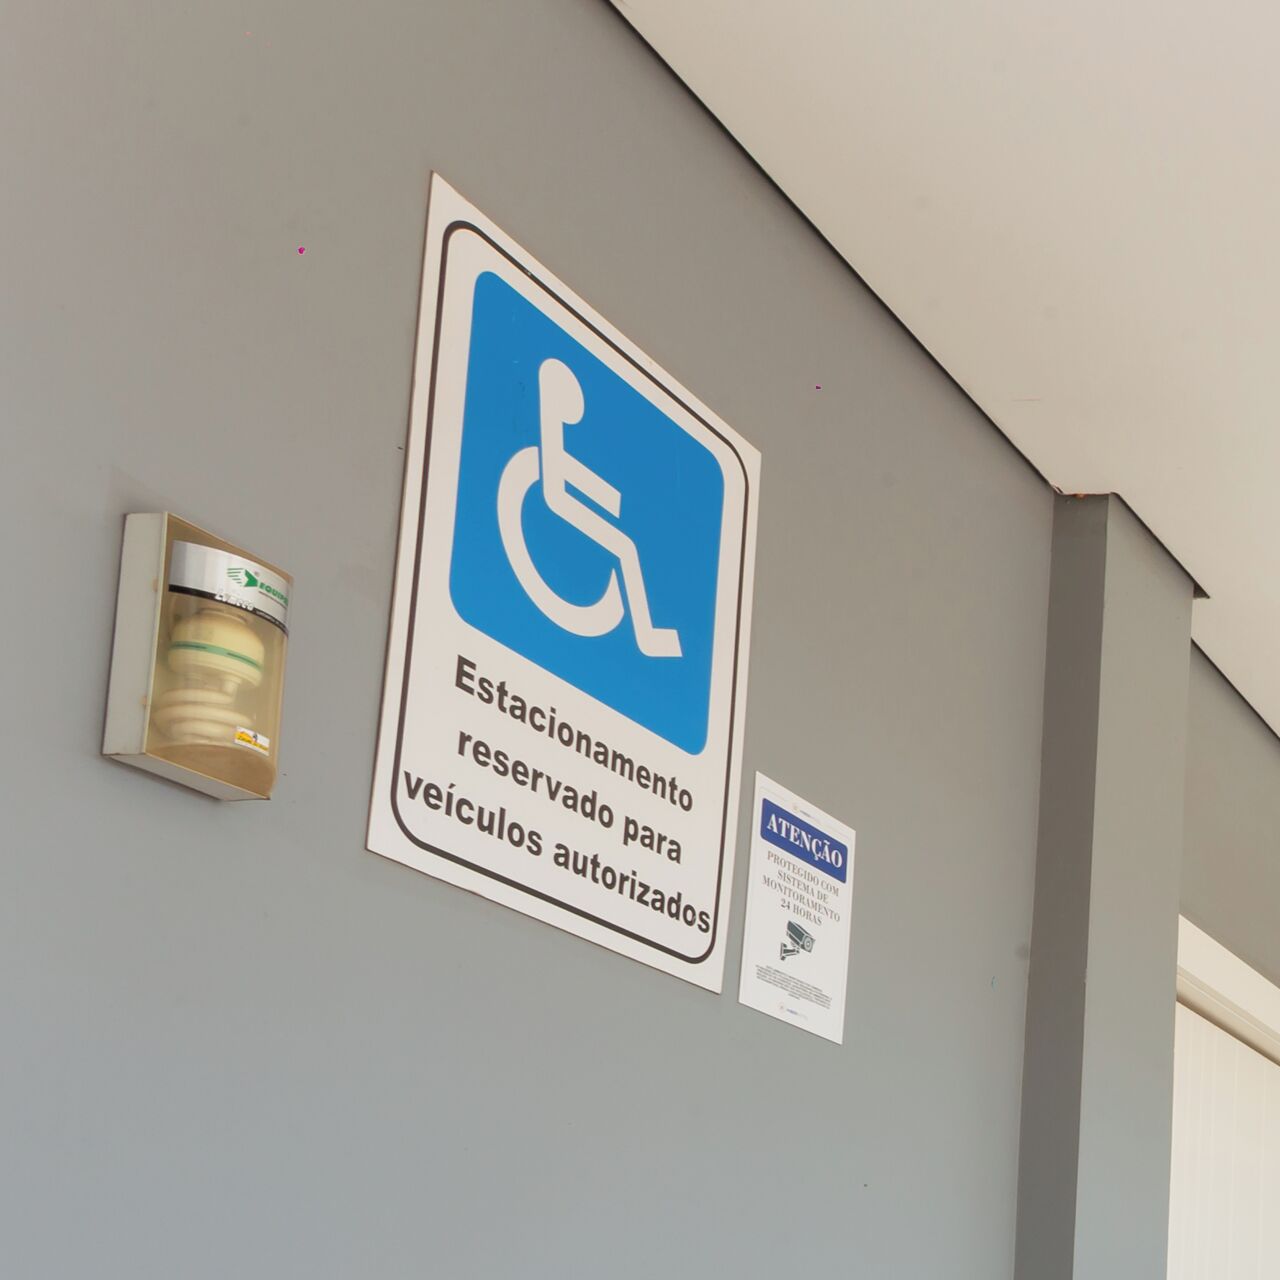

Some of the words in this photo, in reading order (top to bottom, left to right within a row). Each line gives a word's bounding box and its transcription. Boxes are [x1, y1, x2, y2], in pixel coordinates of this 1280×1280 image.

[455, 654, 693, 812] Estacionamento
[457, 730, 615, 829] reservado
[622, 814, 682, 864] para
[403, 770, 543, 857] veículos
[553, 841, 711, 934] autorizados
[767, 813, 843, 868] ATENÇÃO
[762, 875, 841, 922] MONITORAMENTO
[767, 850, 820, 886] PROTEGIDO
[821, 880, 839, 897] COM
[777, 869, 815, 897] SISTEMA
[817, 890, 829, 904] DE
[780, 898, 791, 910] 24
[792, 903, 822, 926] HORAS
